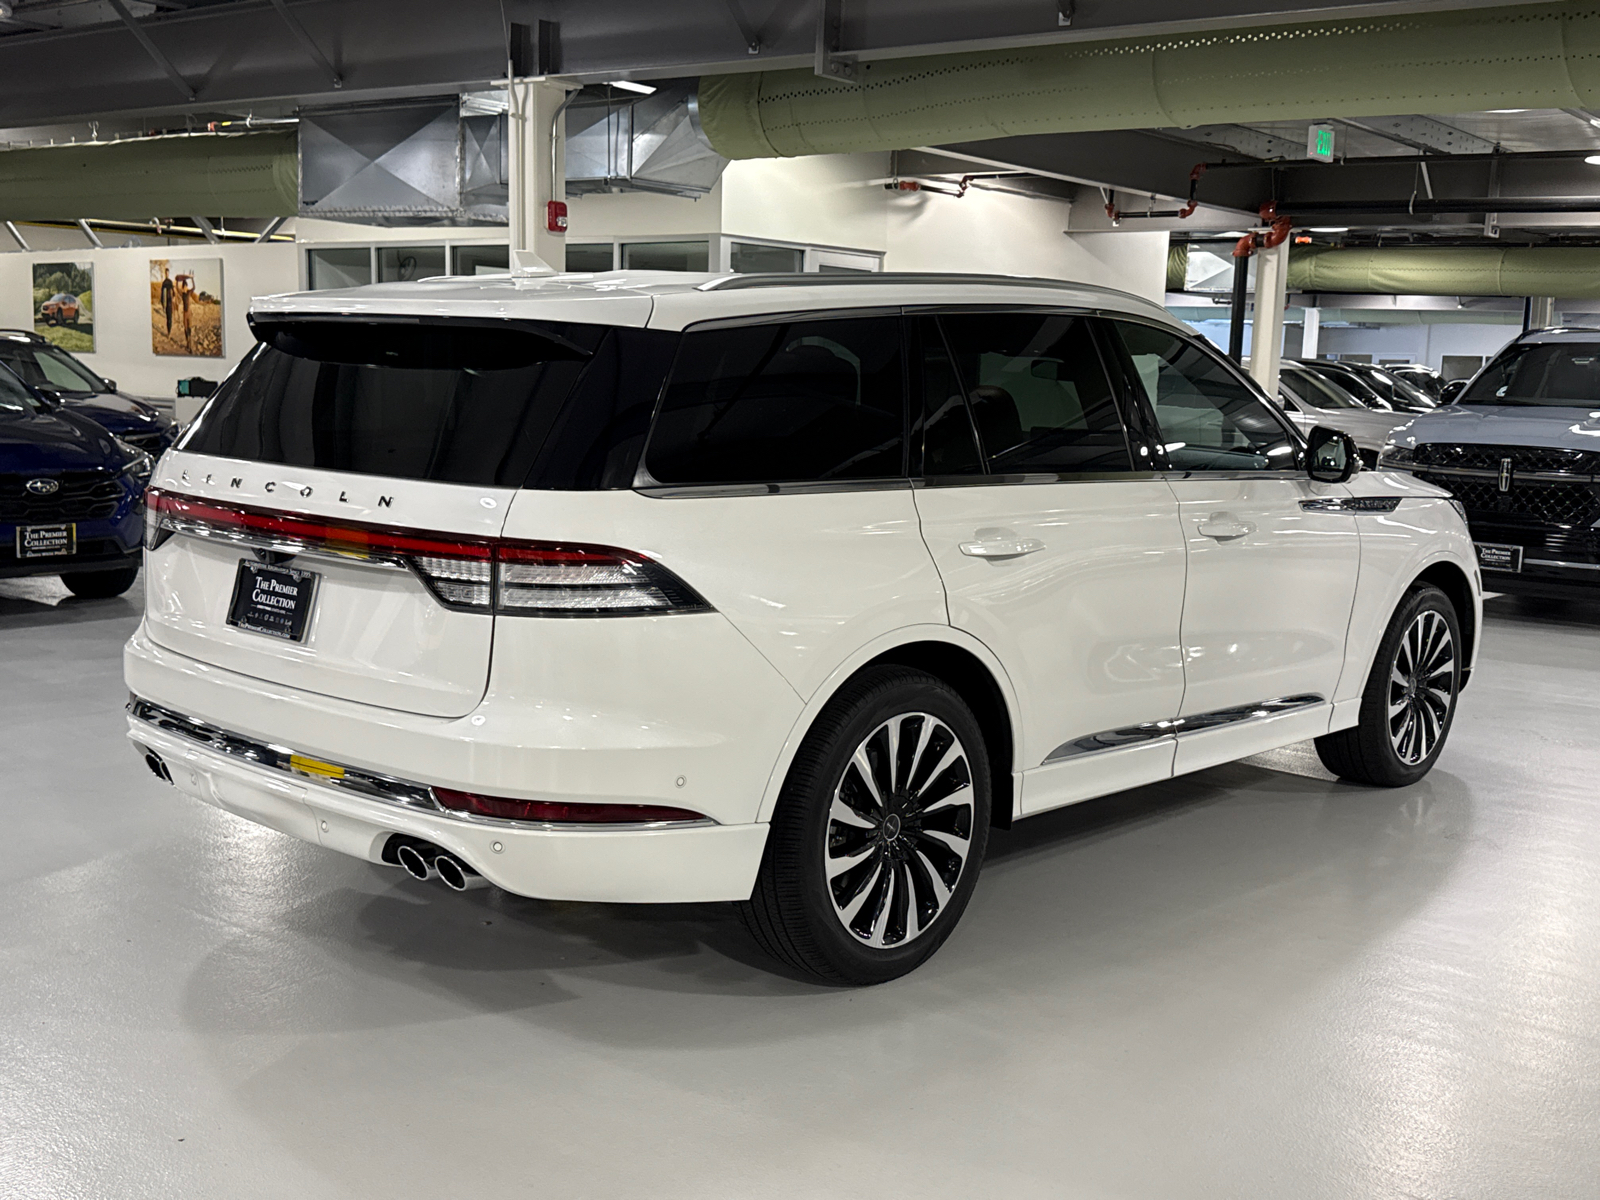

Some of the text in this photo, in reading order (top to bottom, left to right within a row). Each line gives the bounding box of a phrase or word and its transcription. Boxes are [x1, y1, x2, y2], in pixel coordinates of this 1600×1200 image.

[182, 470, 394, 509] LINCOLN
[255, 576, 298, 596] THE PREMIER
[252, 589, 296, 610] COLLECTION
